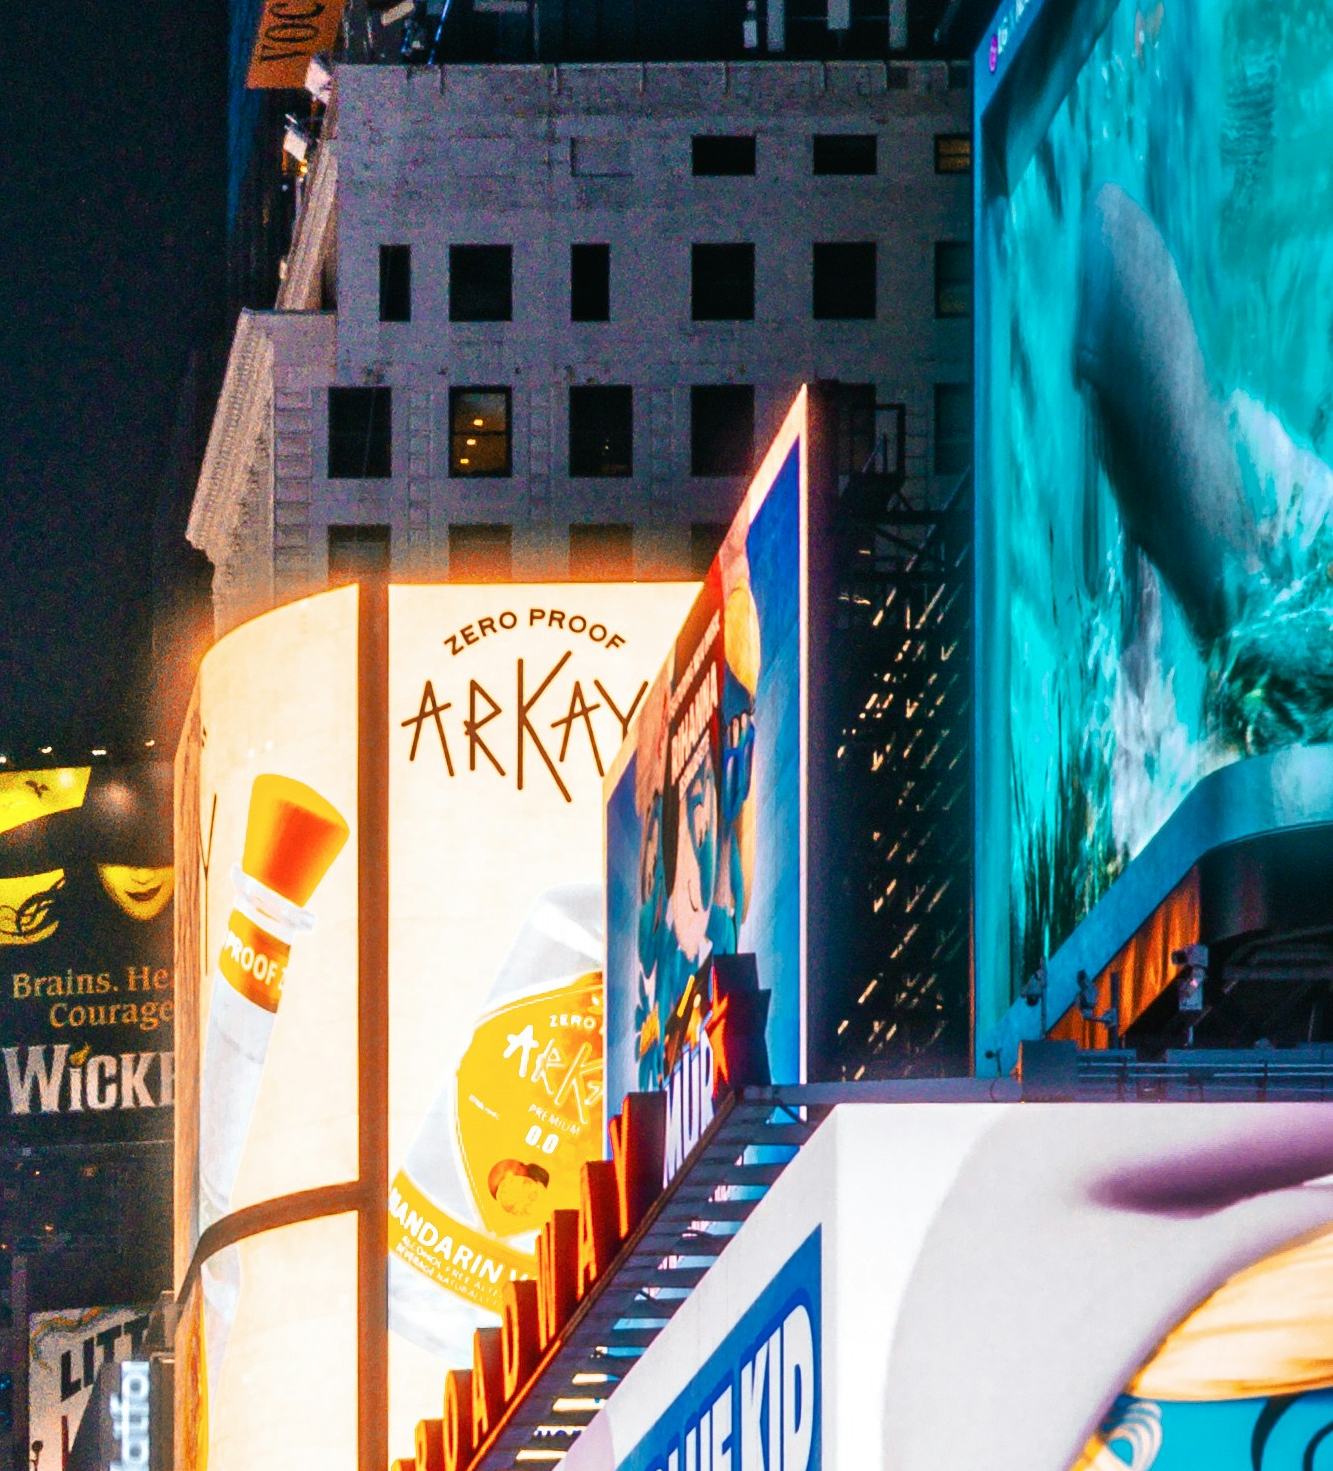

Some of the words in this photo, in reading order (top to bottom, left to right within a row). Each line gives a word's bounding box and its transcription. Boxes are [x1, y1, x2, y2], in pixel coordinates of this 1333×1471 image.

[443, 611, 517, 656] ZERO
[529, 608, 626, 649] PROOF
[401, 650, 649, 802] ARKAY
[12, 969, 118, 999] Brains.
[549, 1014, 596, 1030] ZERO
[528, 1104, 582, 1137] PREMIUM
[525, 1124, 560, 1155] 0.0
